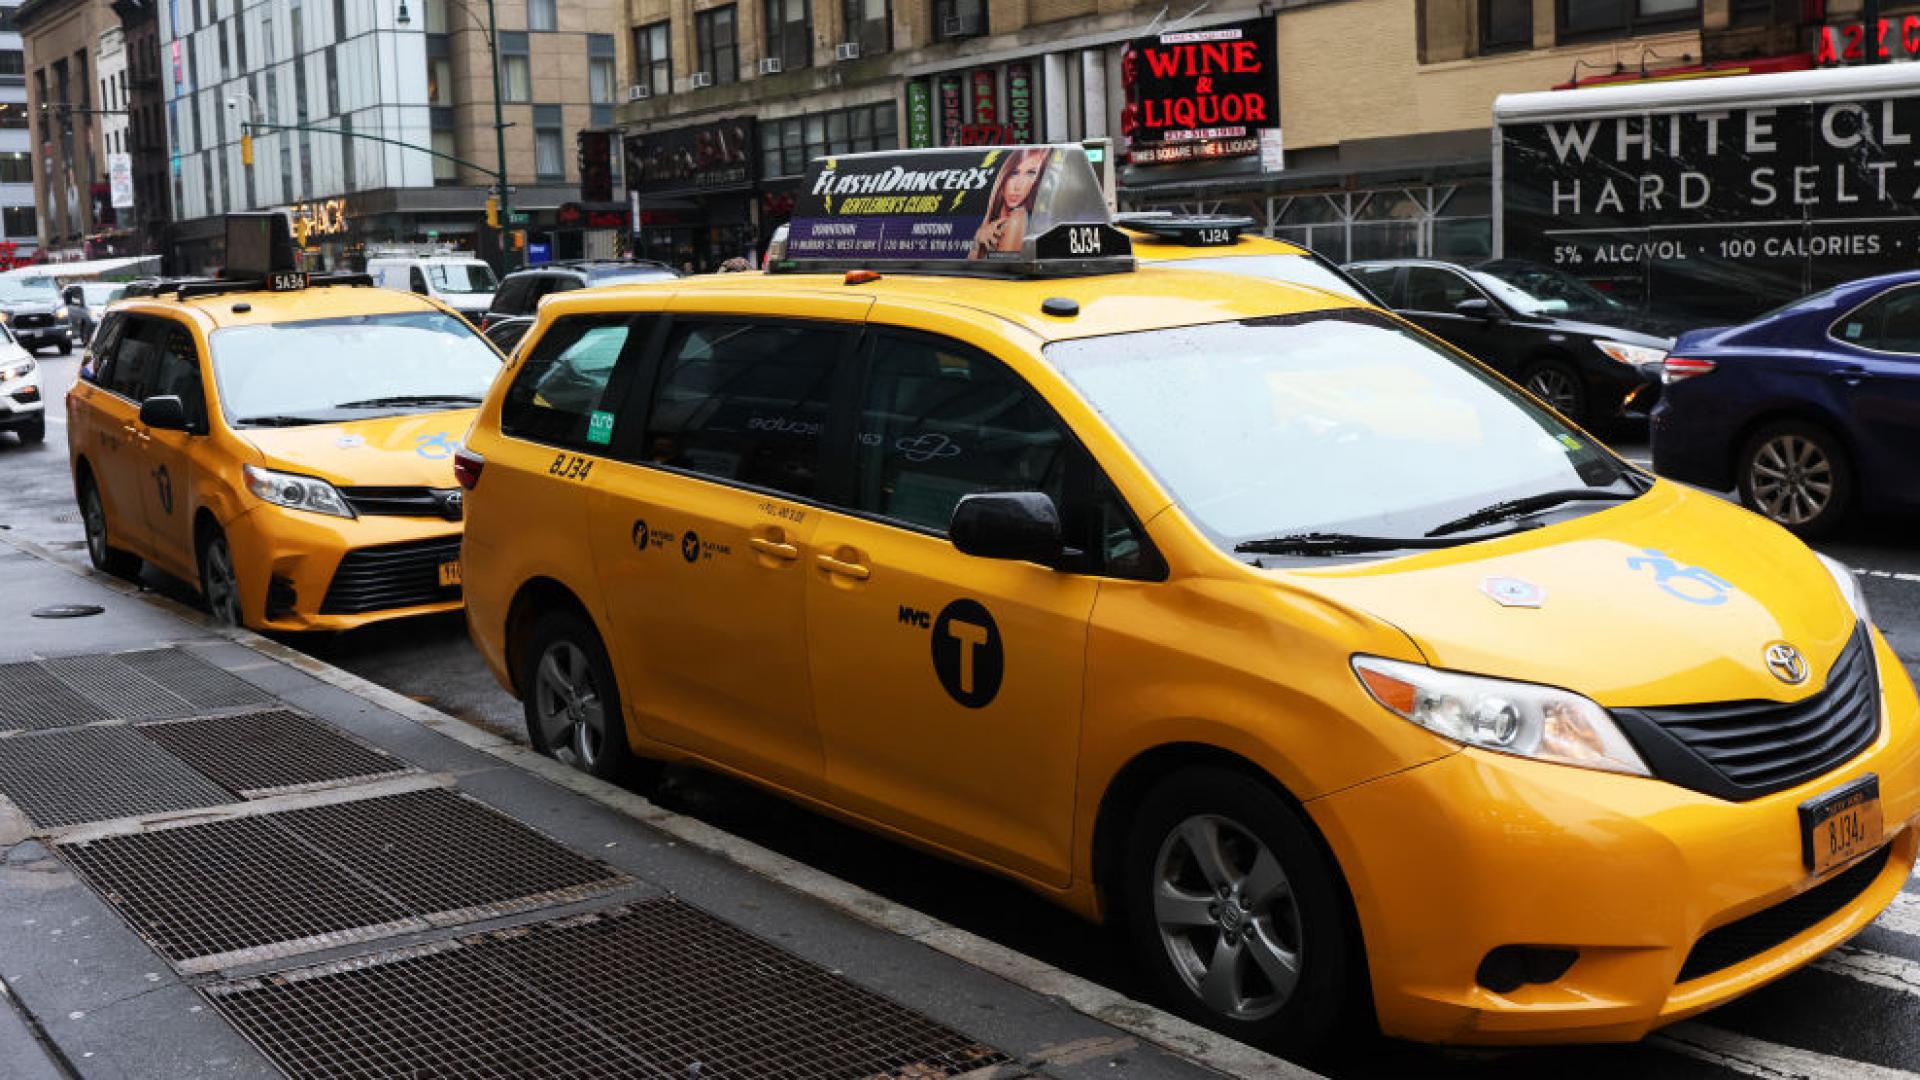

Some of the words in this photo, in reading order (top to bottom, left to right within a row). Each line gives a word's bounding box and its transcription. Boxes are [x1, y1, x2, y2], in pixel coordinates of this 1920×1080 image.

[1143, 41, 1262, 78] WINE
[1196, 76, 1213, 94] &
[1144, 92, 1267, 129] LIQUOR
[1544, 107, 1777, 164] WHITE
[1821, 99, 1912, 149] CL
[839, 196, 909, 215] GENTLEMEN'S
[1553, 173, 1711, 215] HARD
[811, 223, 857, 236] DOWNTOWN
[911, 223, 953, 235] MIDTOWN
[1070, 228, 1101, 253] 8J34
[1199, 230, 1229, 243] 1J24
[1554, 244, 1583, 265] 5%
[1594, 240, 1687, 264] ALC/VOL
[1720, 239, 1756, 258] 100
[1764, 234, 1881, 258] CALORIES
[549, 454, 594, 481] 8J34
[898, 604, 930, 629] NYC
[948, 618, 988, 694] T
